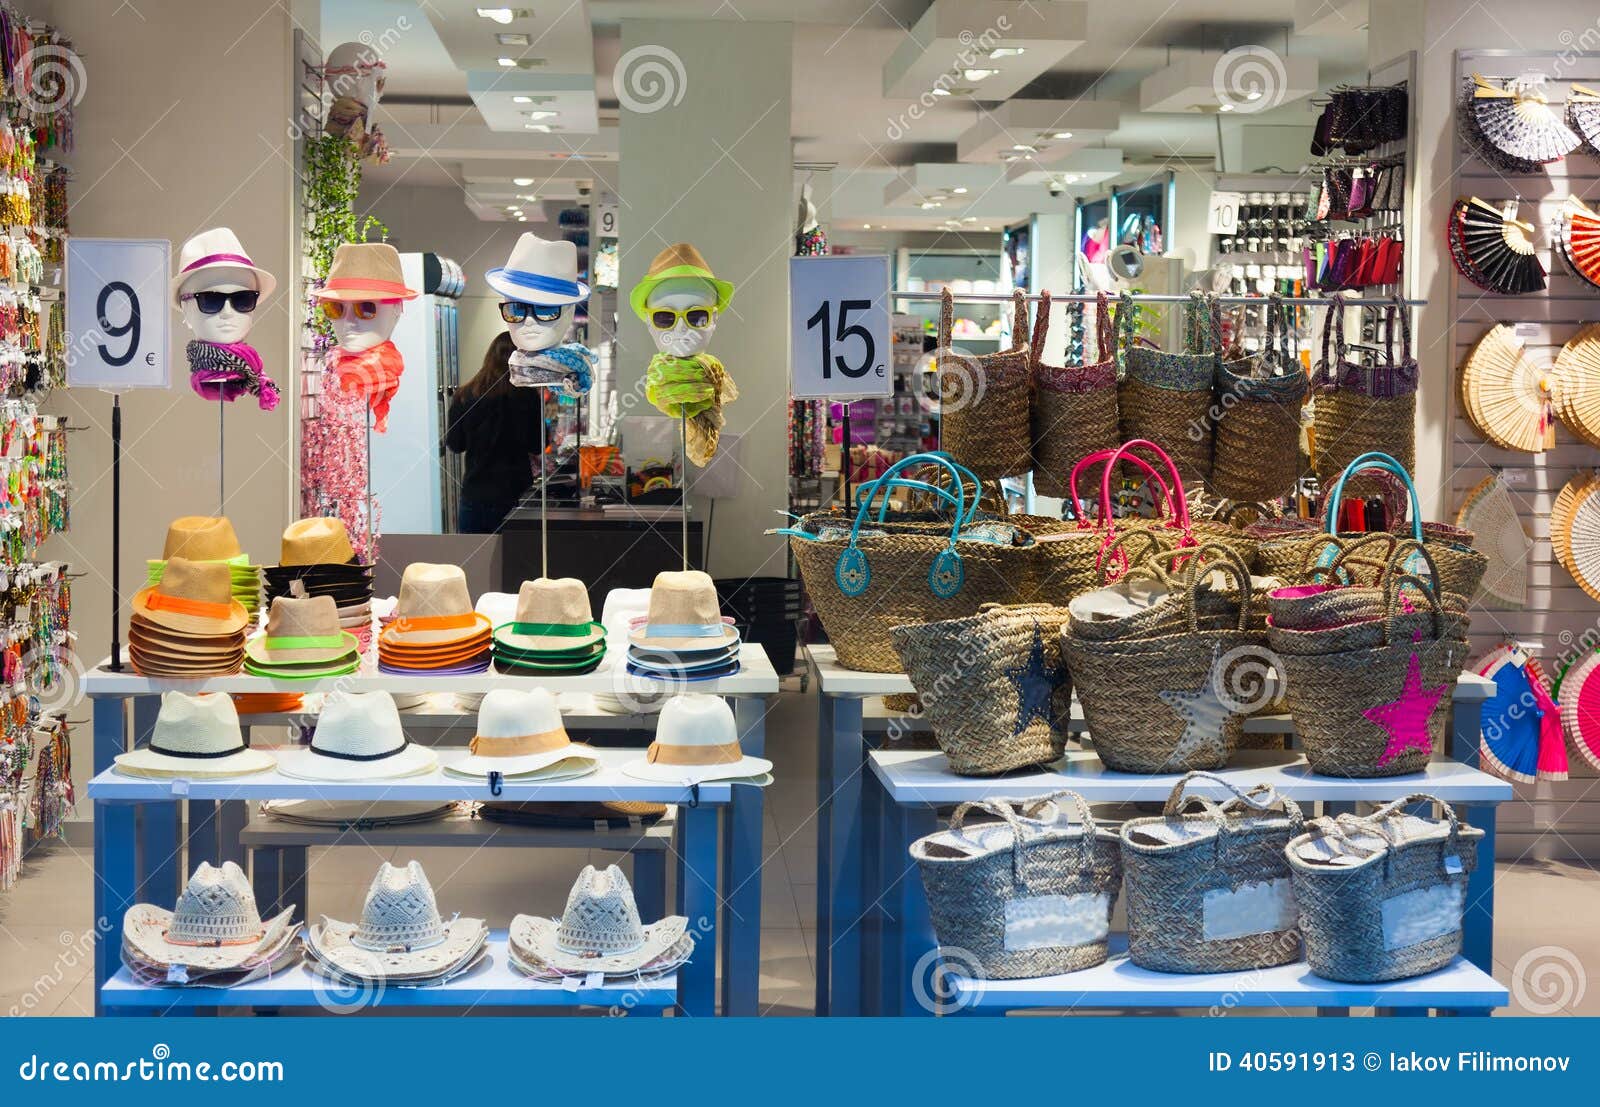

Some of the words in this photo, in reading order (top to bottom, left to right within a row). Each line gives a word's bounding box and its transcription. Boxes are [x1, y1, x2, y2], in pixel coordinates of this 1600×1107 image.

[602, 211, 614, 232] 9
[1214, 204, 1233, 228] 10
[96, 281, 141, 367] 9
[807, 300, 875, 379] 15
